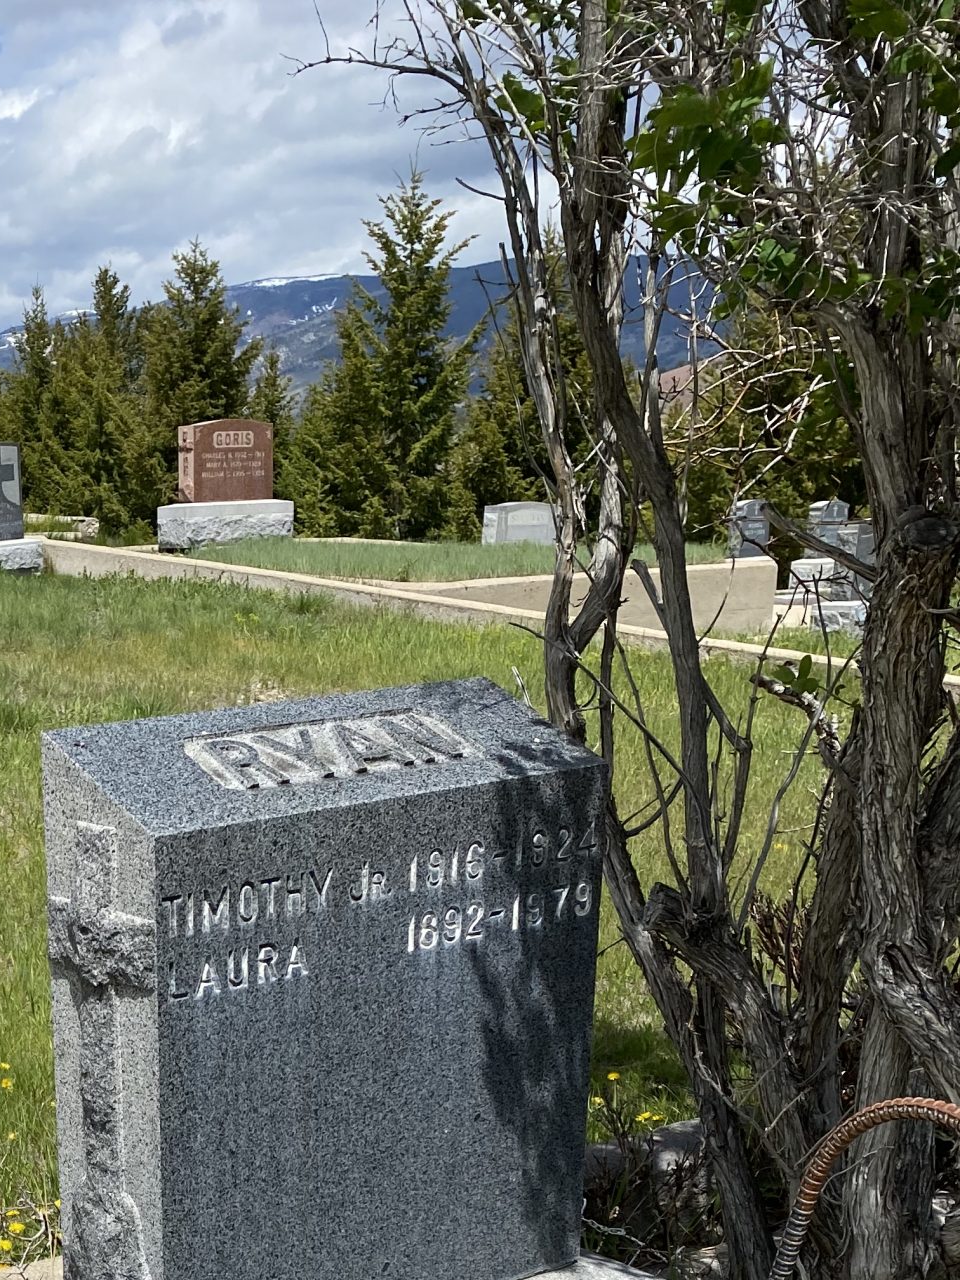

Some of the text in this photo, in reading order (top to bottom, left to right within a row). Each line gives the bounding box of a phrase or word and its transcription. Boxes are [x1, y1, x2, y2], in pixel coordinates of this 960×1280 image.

[216, 432, 252, 447] GORIS
[200, 712, 464, 790] RYAN
[161, 866, 334, 938] TIMOTHY
[167, 936, 309, 1001] LAURA
